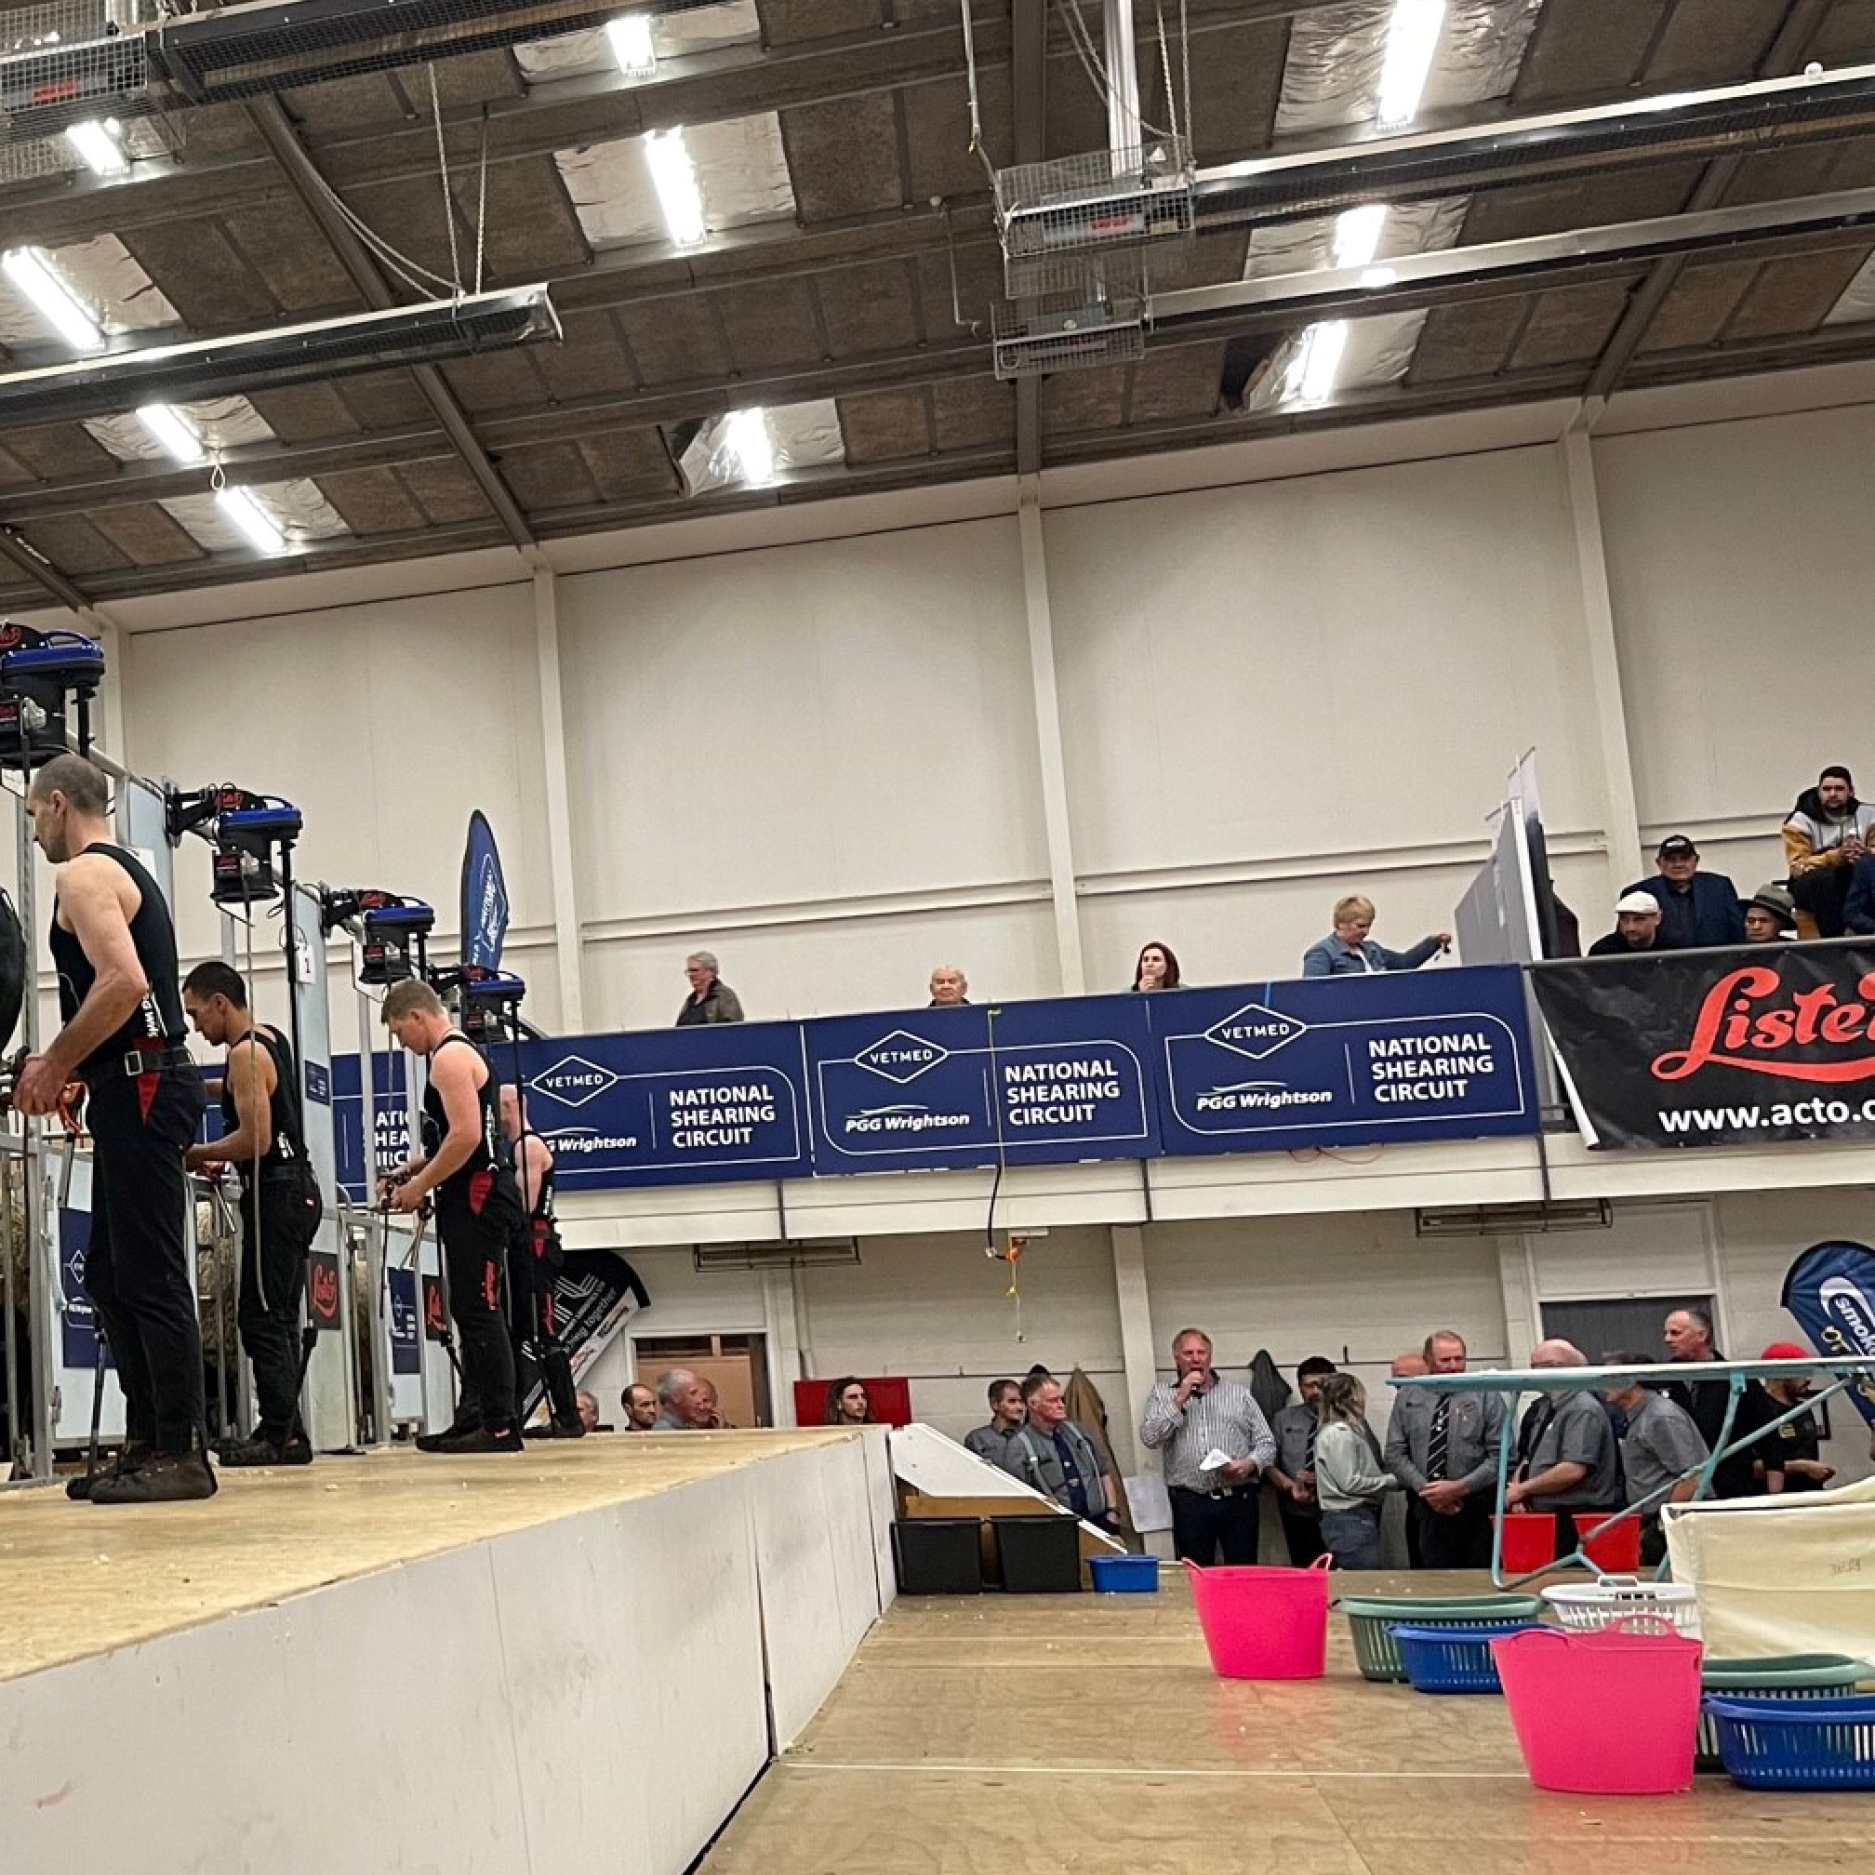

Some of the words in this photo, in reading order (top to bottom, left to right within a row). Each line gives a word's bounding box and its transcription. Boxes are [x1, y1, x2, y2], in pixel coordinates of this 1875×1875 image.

[304, 957, 312, 974] 1
[1221, 1023, 1290, 1040] VETMED
[1650, 966, 1875, 1083] Liste
[870, 1050, 934, 1064] VETMED
[1368, 1032, 1492, 1059] NATIONAL
[1005, 1058, 1119, 1083] NATIONAL
[1371, 1055, 1495, 1081] SHEARING
[545, 1074, 604, 1089] VETMED
[1007, 1080, 1120, 1104] SHEARING
[1374, 1078, 1469, 1103] CIRCUIT
[669, 1084, 775, 1108] NATIONAL
[1196, 1096, 1237, 1111] PGG
[1239, 1090, 1333, 1110] Wrightson
[670, 1104, 776, 1128] SHEARING
[845, 1117, 881, 1133] PGG
[884, 1113, 970, 1132] Wrightson
[1009, 1104, 1096, 1126] CIRCUIT
[1657, 1097, 1875, 1132] www.acto.c
[558, 1136, 637, 1154] Wrightson
[672, 1127, 753, 1149] CIRCUIT
[1835, 1295, 1875, 1357] smok
